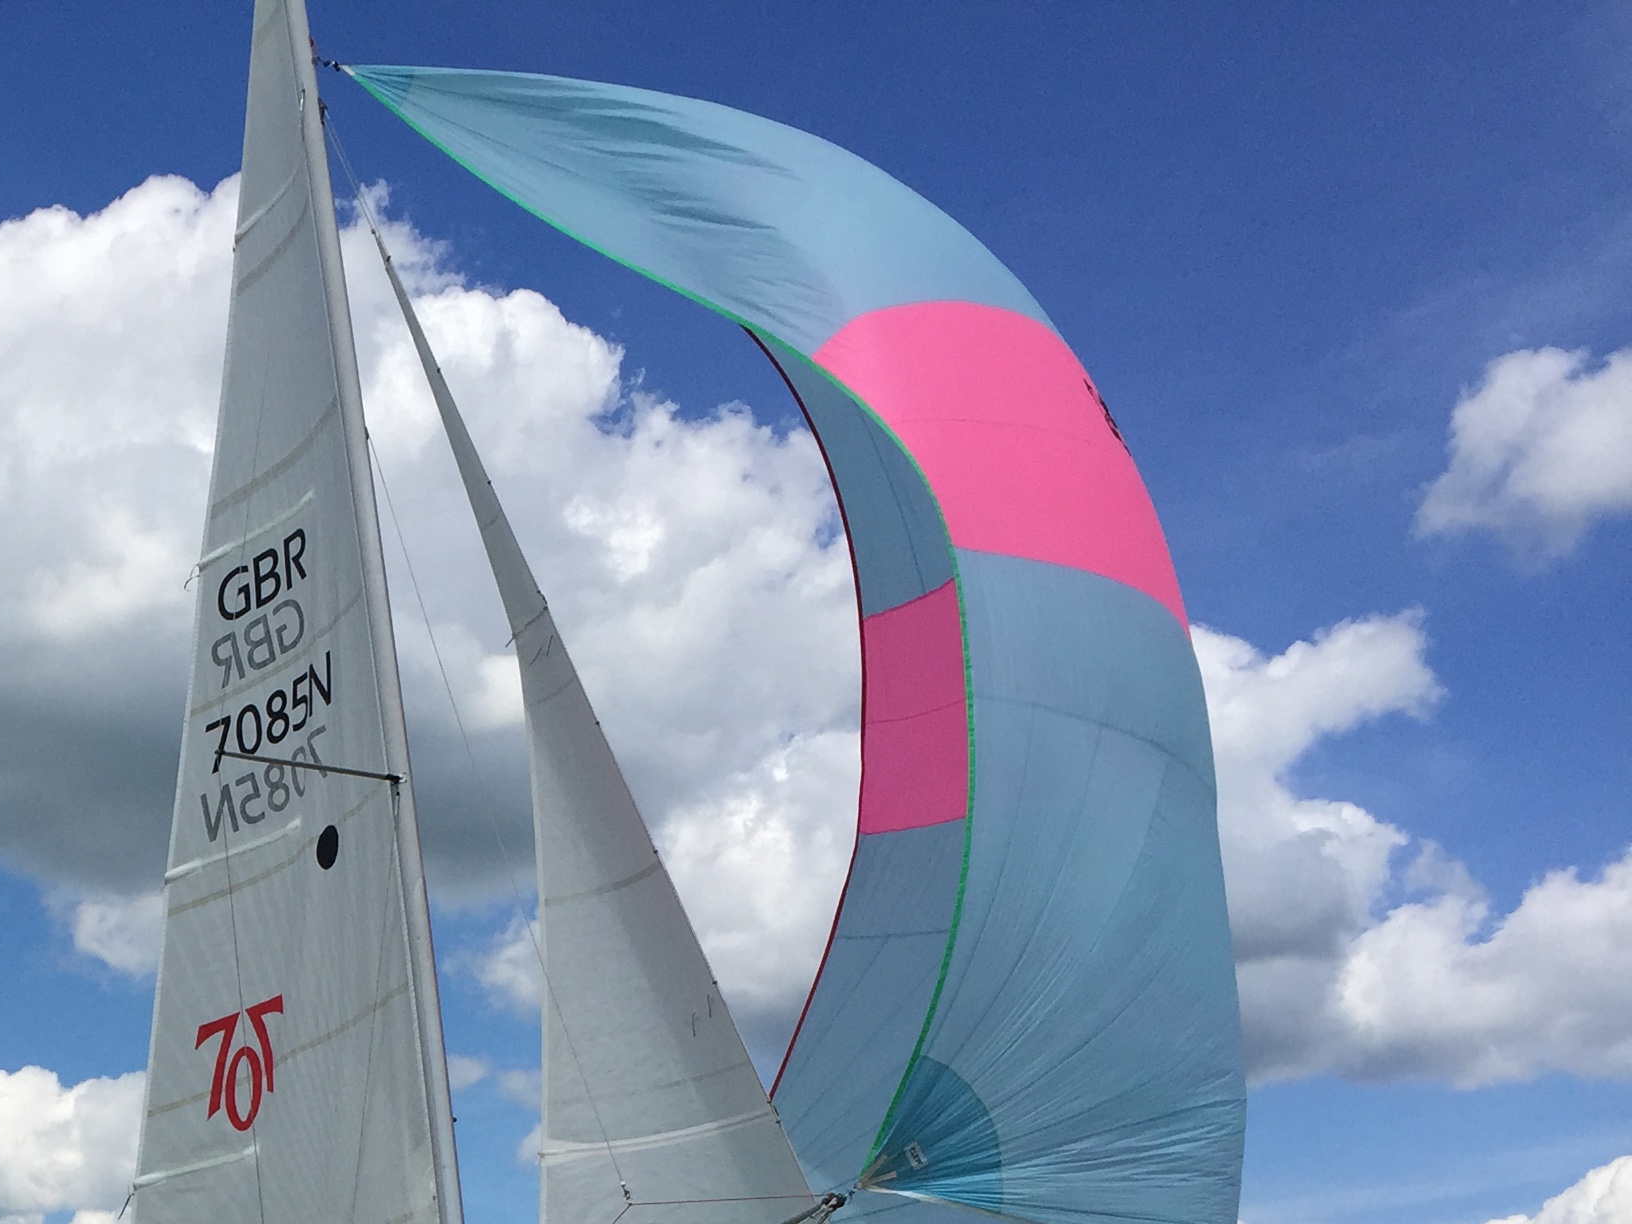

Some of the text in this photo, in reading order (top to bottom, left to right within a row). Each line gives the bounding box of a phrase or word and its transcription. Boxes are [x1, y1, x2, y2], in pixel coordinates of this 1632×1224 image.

[217, 528, 307, 620] GBR
[205, 650, 331, 774] 7085N
[195, 993, 284, 1131] 707
